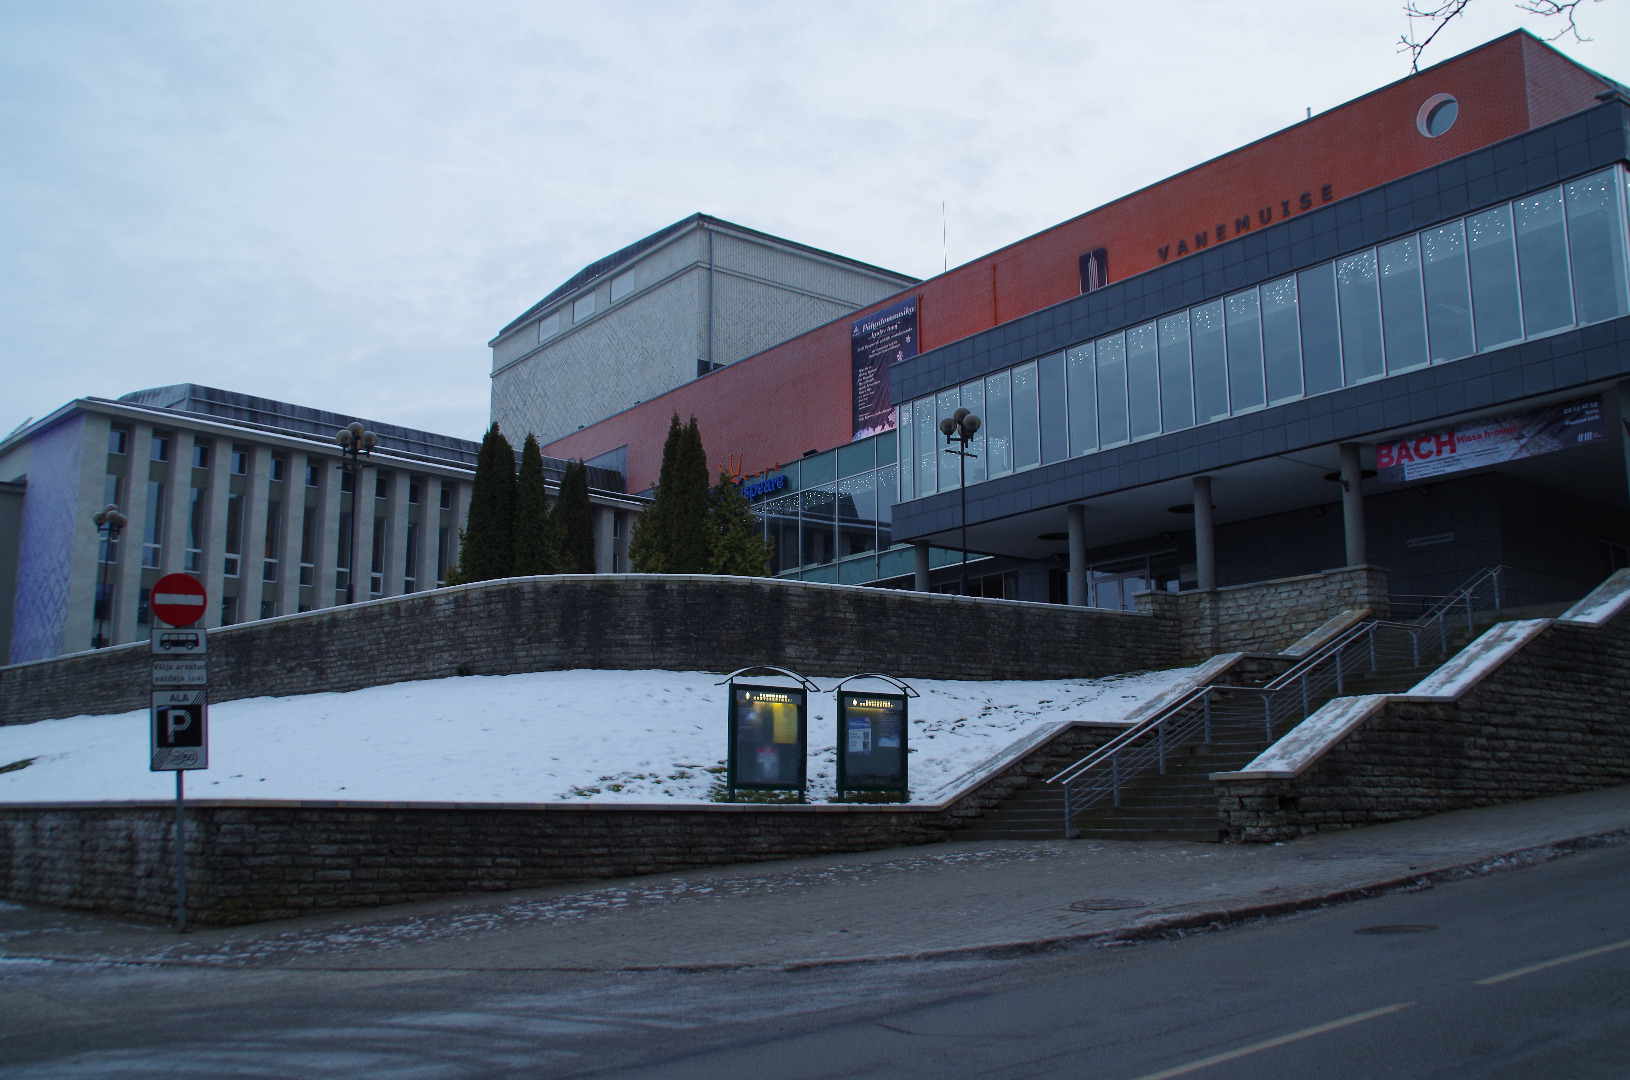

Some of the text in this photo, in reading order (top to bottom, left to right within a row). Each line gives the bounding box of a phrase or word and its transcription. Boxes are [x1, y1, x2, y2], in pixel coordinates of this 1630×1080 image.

[1157, 183, 1333, 261] VANEMUISE
[1376, 430, 1457, 469] BACH
[1456, 432, 1483, 444] Missa
[741, 474, 786, 502] speare
[169, 694, 189, 702] ALA
[167, 709, 192, 743] P
